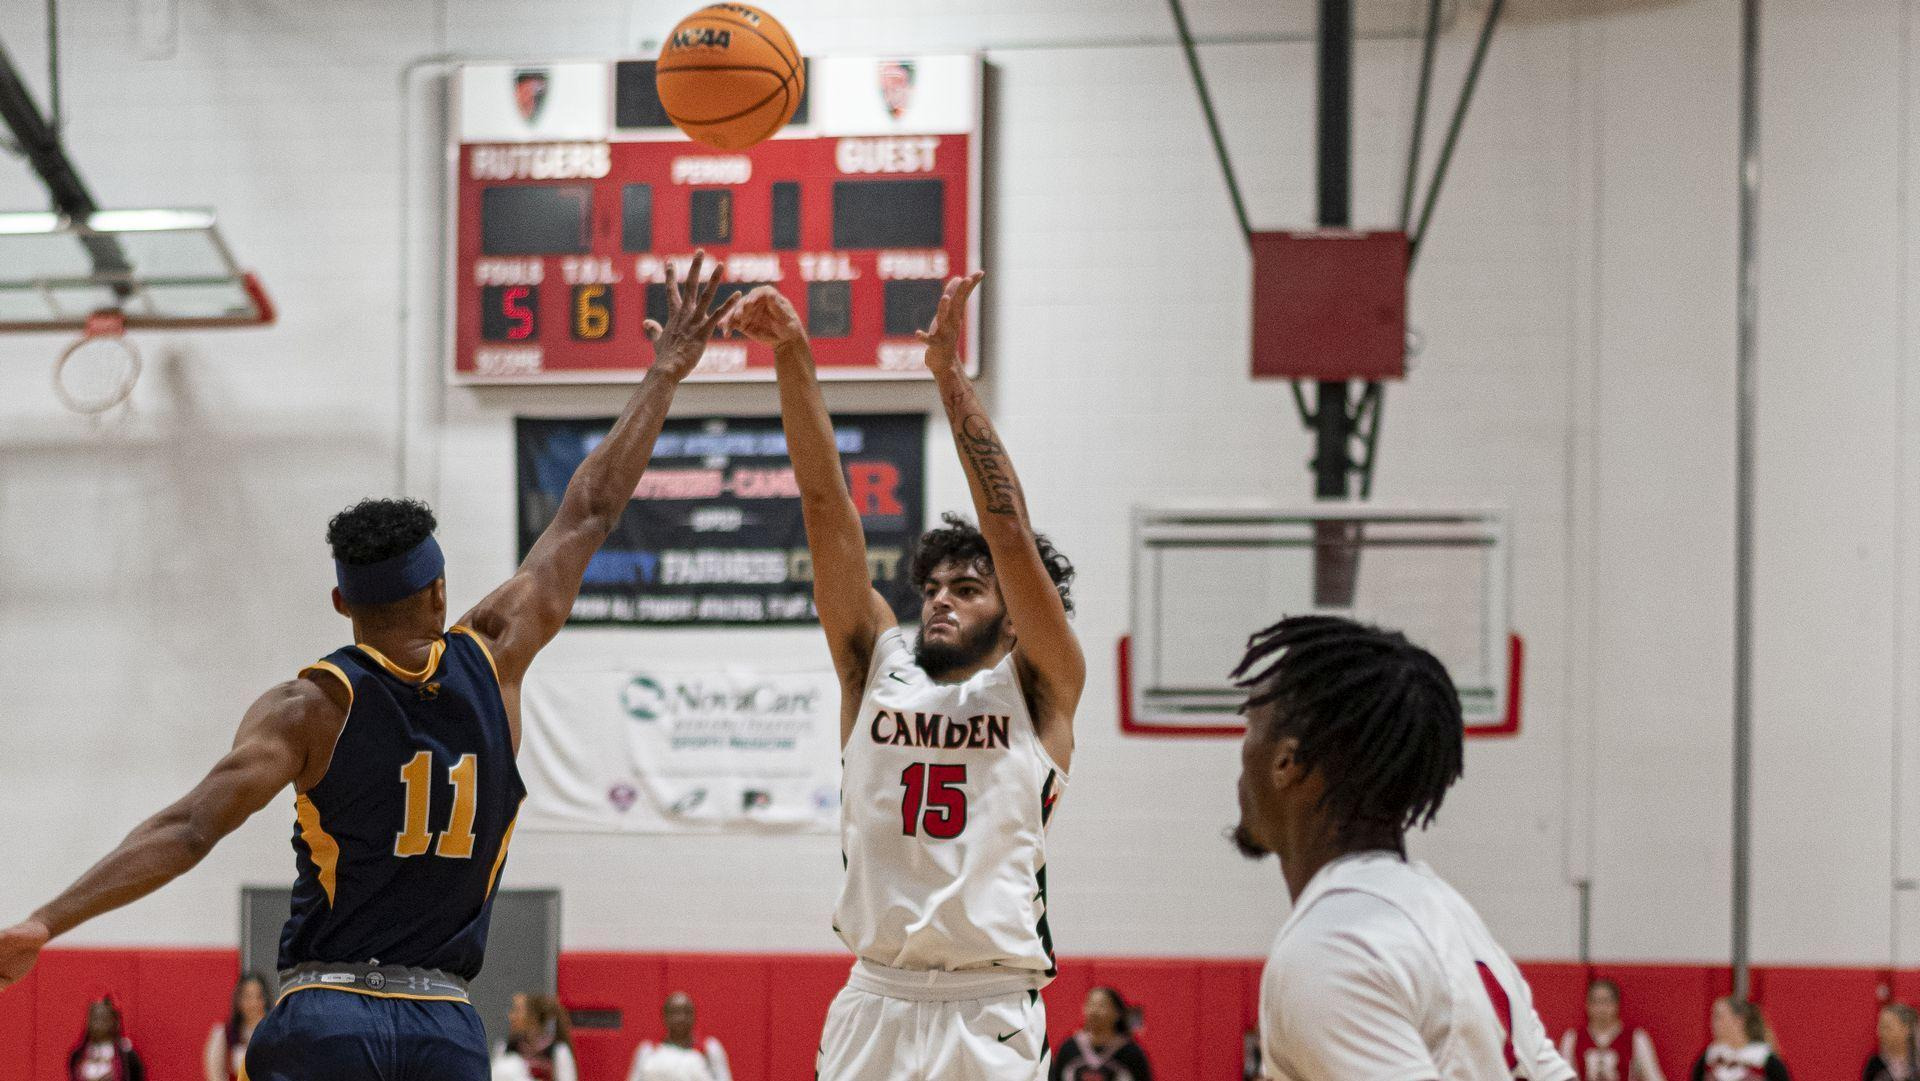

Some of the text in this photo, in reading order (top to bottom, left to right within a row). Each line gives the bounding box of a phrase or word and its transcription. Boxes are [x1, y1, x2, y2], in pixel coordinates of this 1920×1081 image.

[673, 28, 731, 48] NCAA
[471, 143, 611, 179] RUTGERS
[671, 156, 751, 185] PERIOD
[835, 138, 940, 173] GUEST
[474, 256, 544, 285] FOULS
[878, 250, 949, 280] FOULS
[502, 285, 536, 340] 5
[577, 286, 611, 340] 6
[847, 460, 904, 516] R
[672, 683, 820, 714] NovaCare
[871, 710, 1011, 750] CAMDEN
[394, 751, 478, 859] 11
[900, 761, 968, 839] 15
